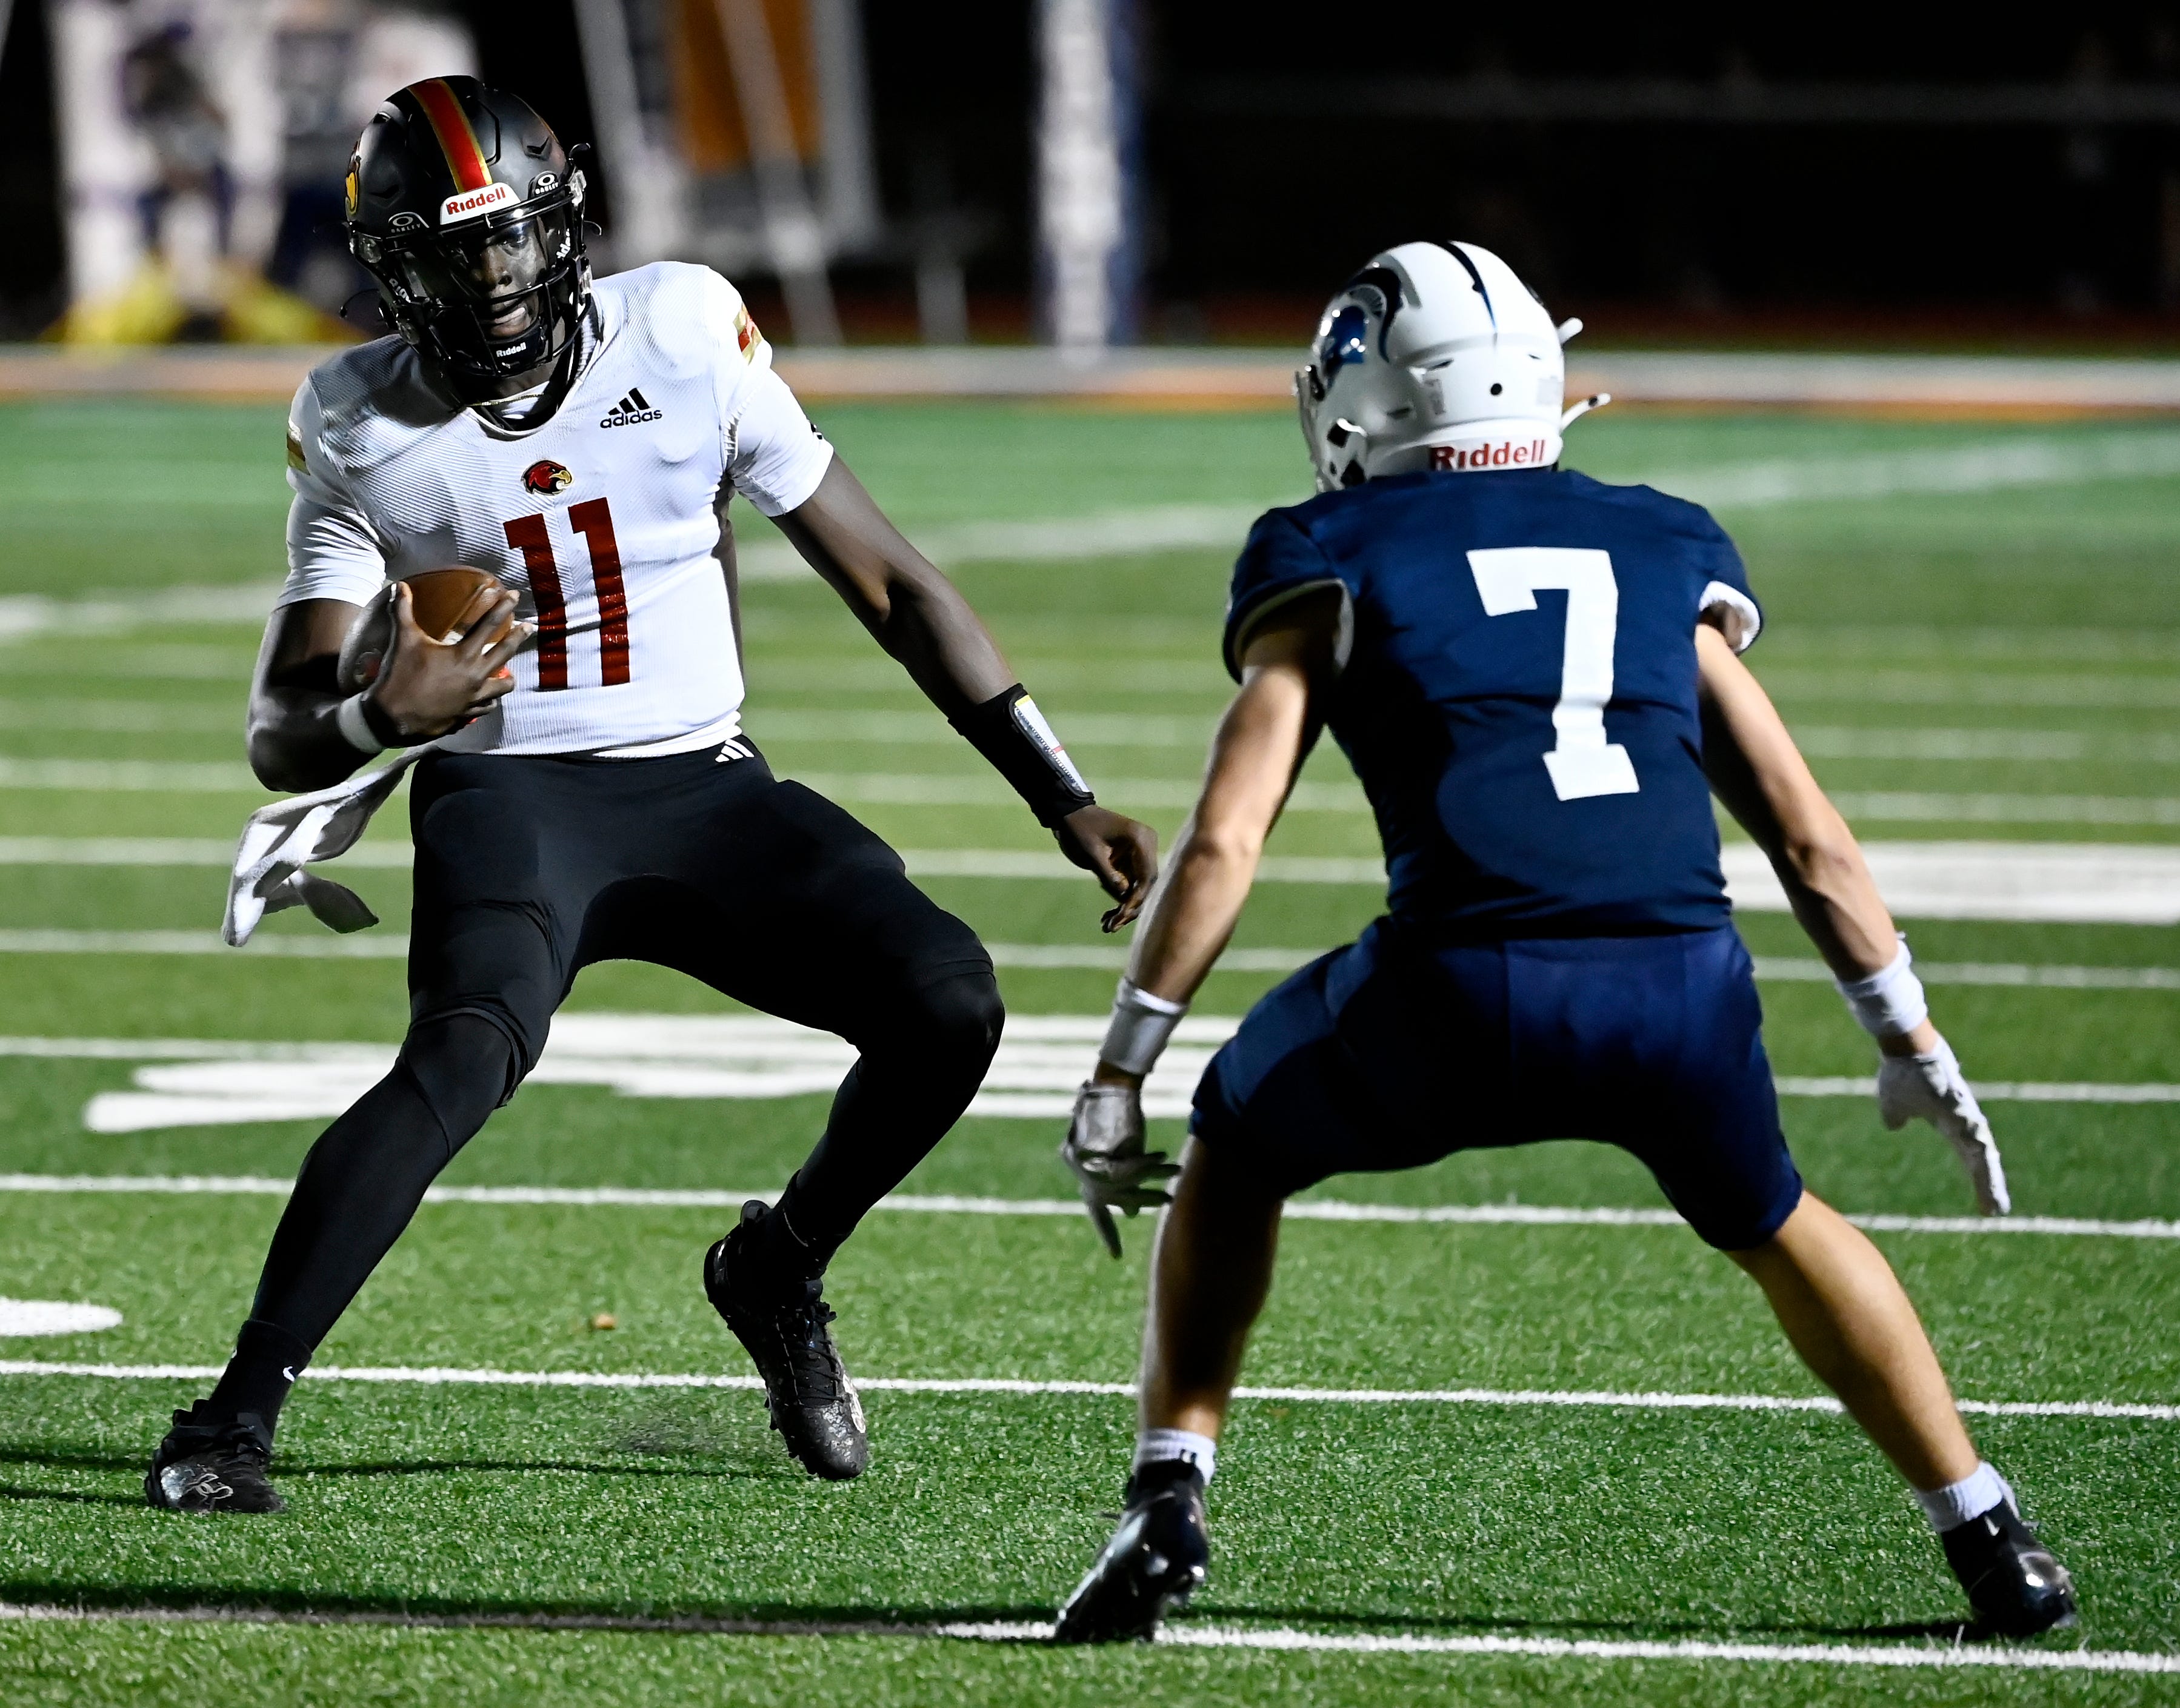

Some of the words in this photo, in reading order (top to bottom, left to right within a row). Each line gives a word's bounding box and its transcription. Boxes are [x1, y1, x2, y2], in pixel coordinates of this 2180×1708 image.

[446, 187, 506, 215] Riddell
[600, 410, 662, 428] adidas
[1430, 439, 1545, 471] Riddell
[502, 497, 630, 689] 11
[1467, 547, 1640, 802] 7
